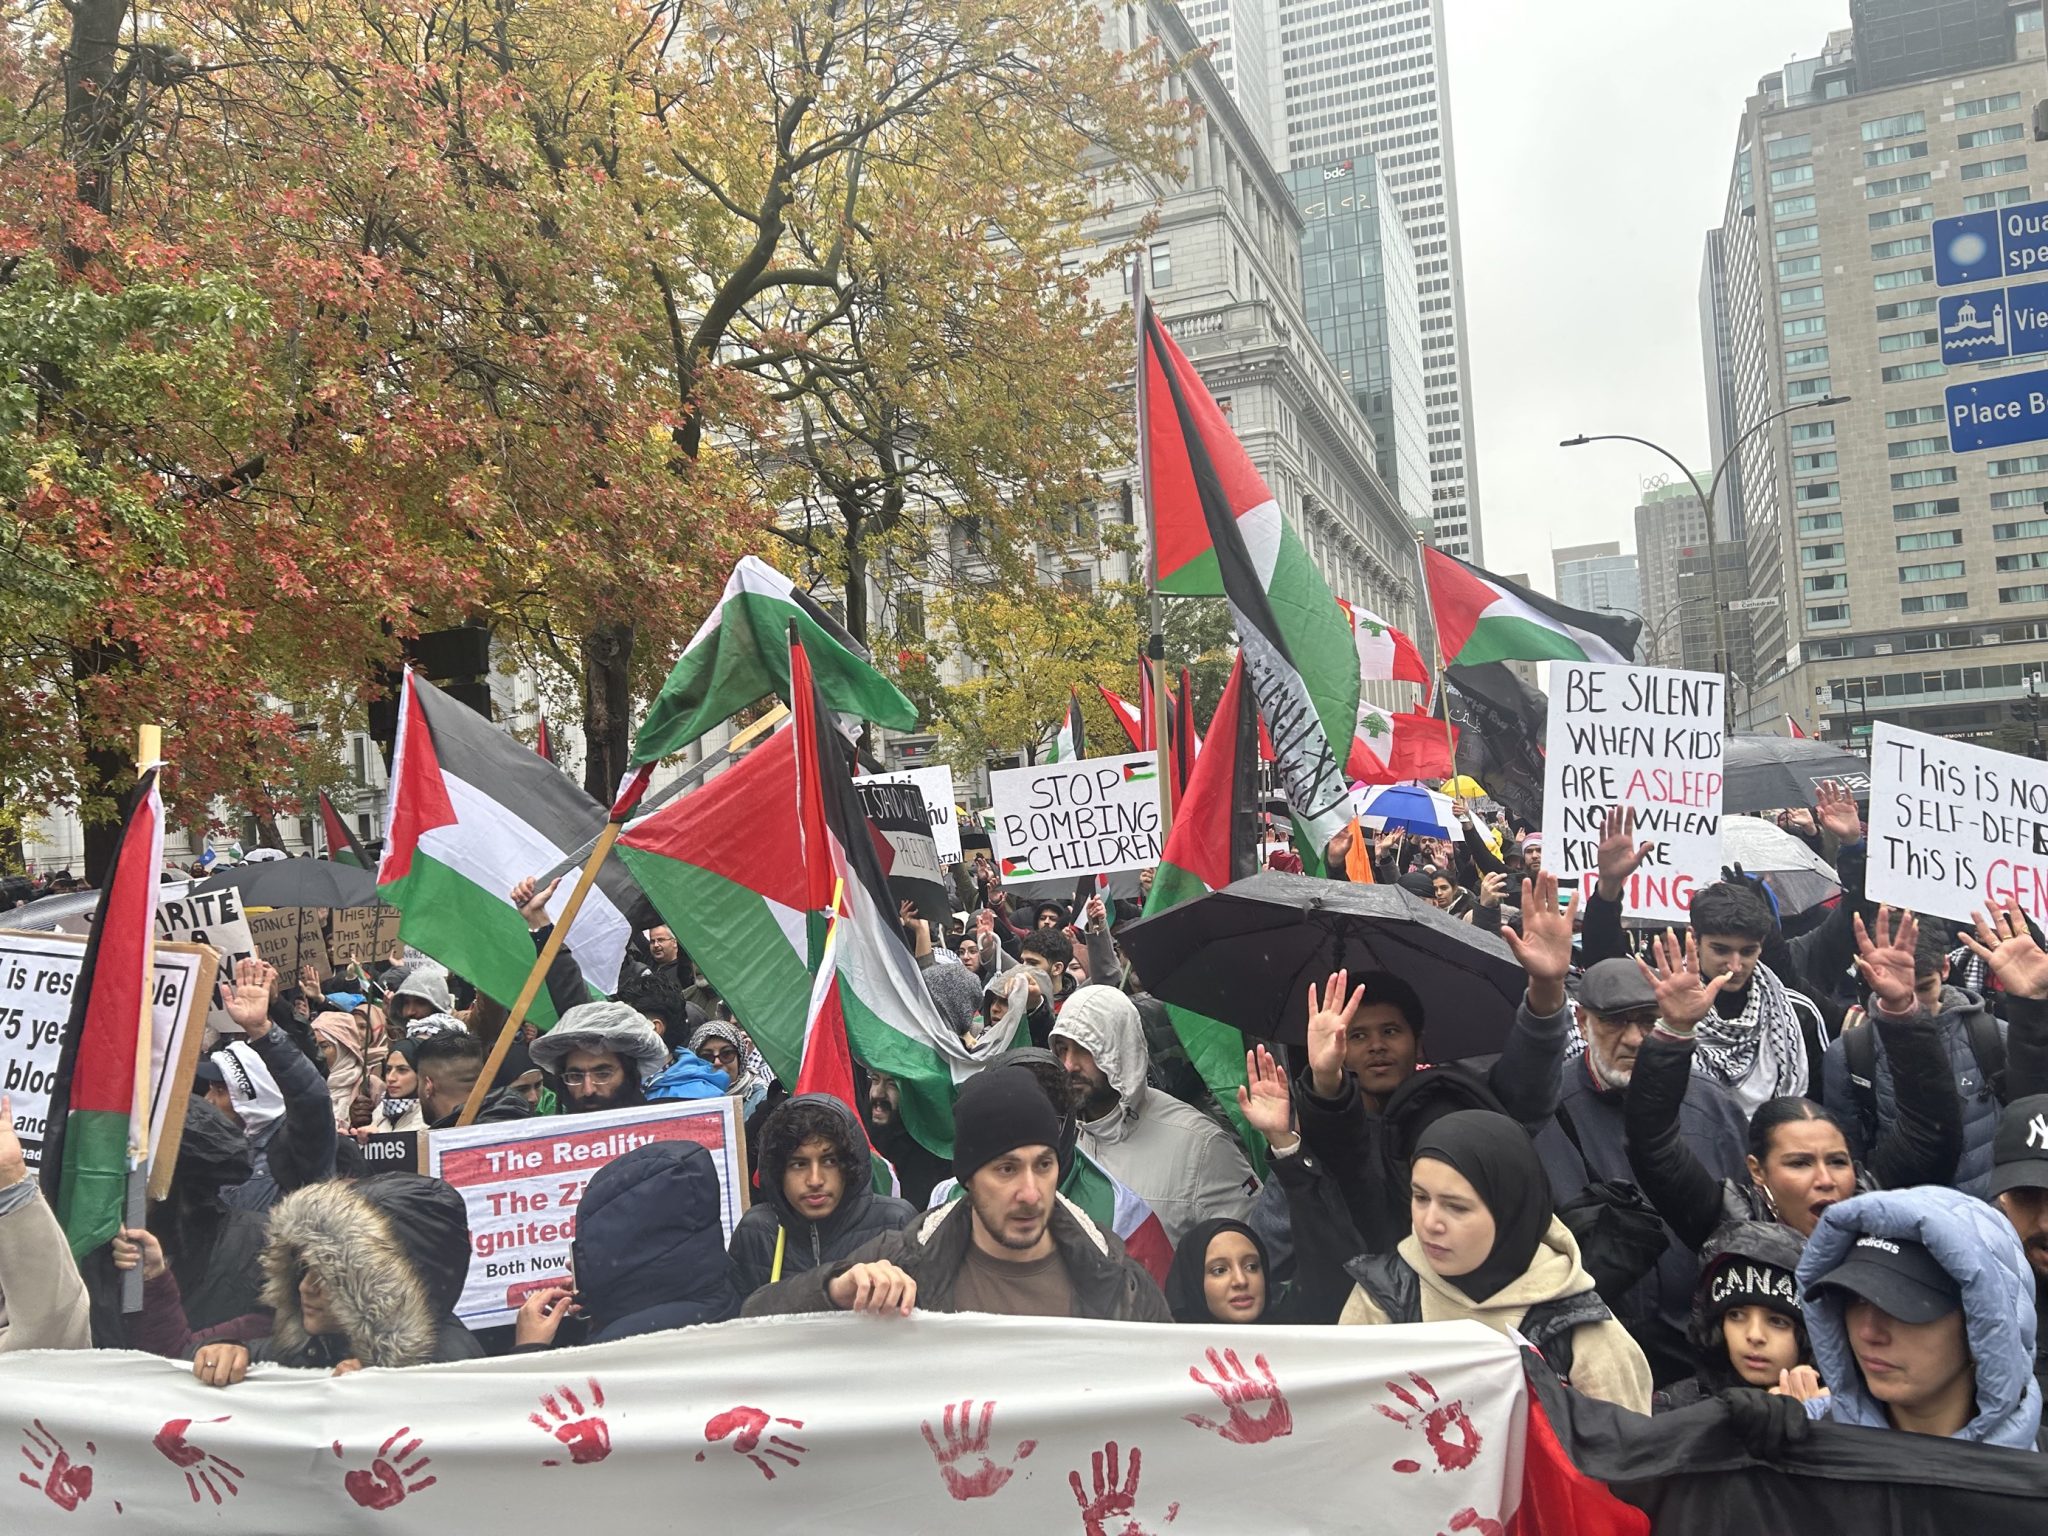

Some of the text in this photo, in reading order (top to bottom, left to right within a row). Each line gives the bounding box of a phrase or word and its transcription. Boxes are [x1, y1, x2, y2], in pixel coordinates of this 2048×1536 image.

[1324, 167, 1345, 180] bdc
[1953, 400, 2022, 427] Place
[1566, 669, 1721, 717] BE SILENT
[1566, 722, 1654, 758] WHEN
[1562, 765, 1618, 801] ARE
[1625, 768, 1723, 808] ASLEEP
[1887, 741, 1966, 796] This
[1974, 765, 1999, 802] is
[1029, 769, 1120, 809] STOP
[1004, 801, 1158, 846] BOMBING
[1632, 807, 1718, 836] WHEN
[1027, 832, 1163, 873] CHILDREN
[1883, 835, 1946, 881] This
[1955, 851, 1977, 890] is
[302, 910, 314, 925] IS
[340, 908, 365, 922] THIS
[335, 931, 360, 941] THIS
[6, 959, 28, 991] is
[486, 1132, 655, 1173] The Reality
[486, 1191, 549, 1216] The
[1857, 1236, 1900, 1255] adidas
[486, 1256, 566, 1278] Both Now
